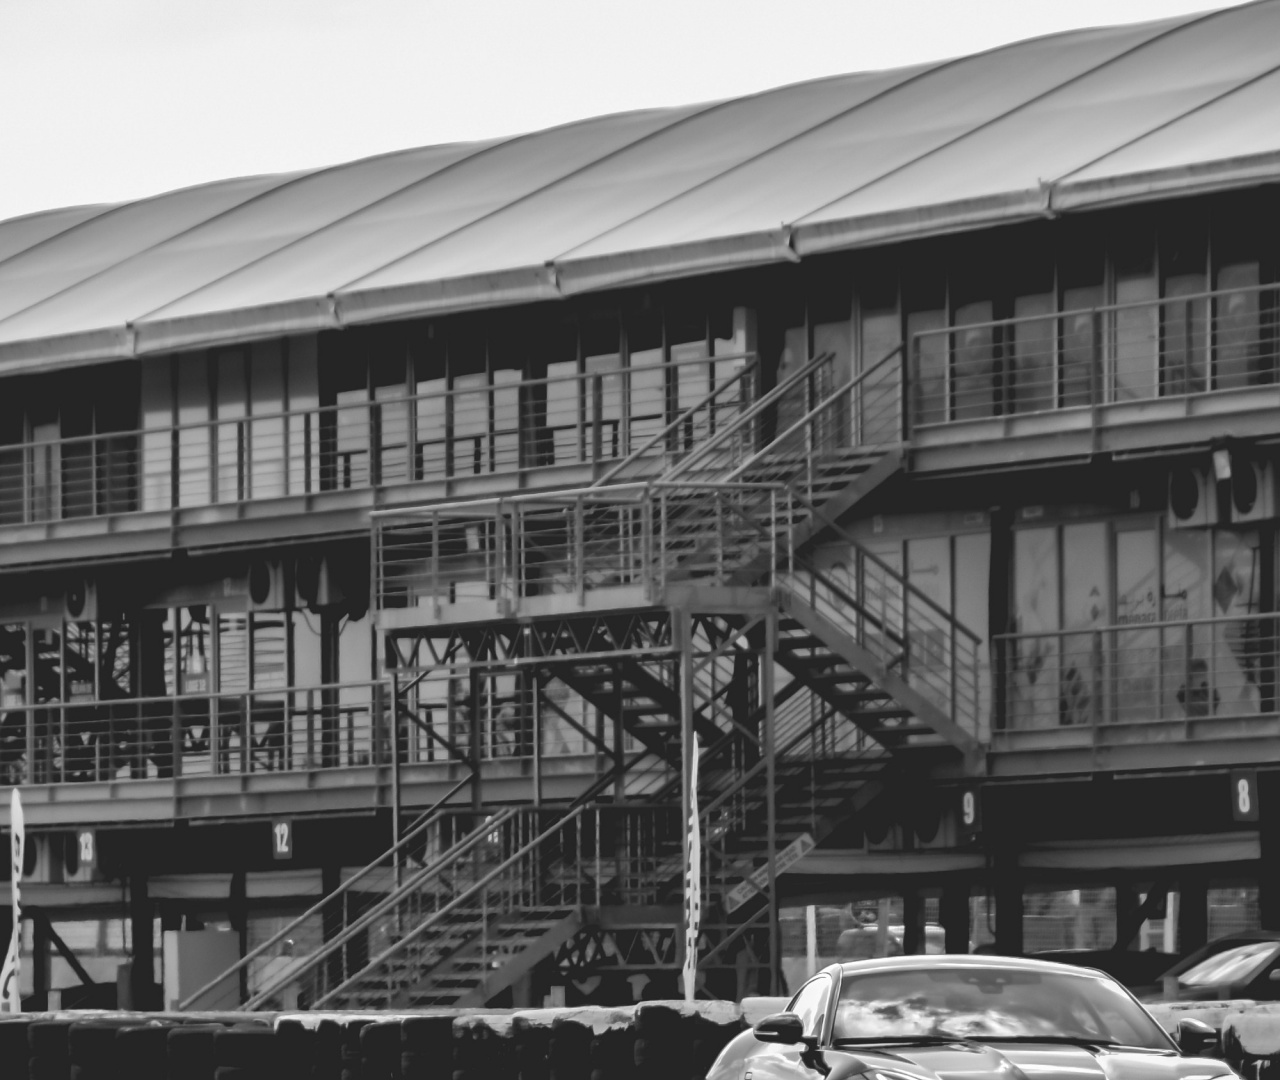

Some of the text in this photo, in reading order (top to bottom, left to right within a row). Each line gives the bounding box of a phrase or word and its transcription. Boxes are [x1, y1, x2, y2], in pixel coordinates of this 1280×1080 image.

[963, 791, 974, 825] 9
[1237, 778, 1251, 813] 8
[274, 822, 289, 853] 12
